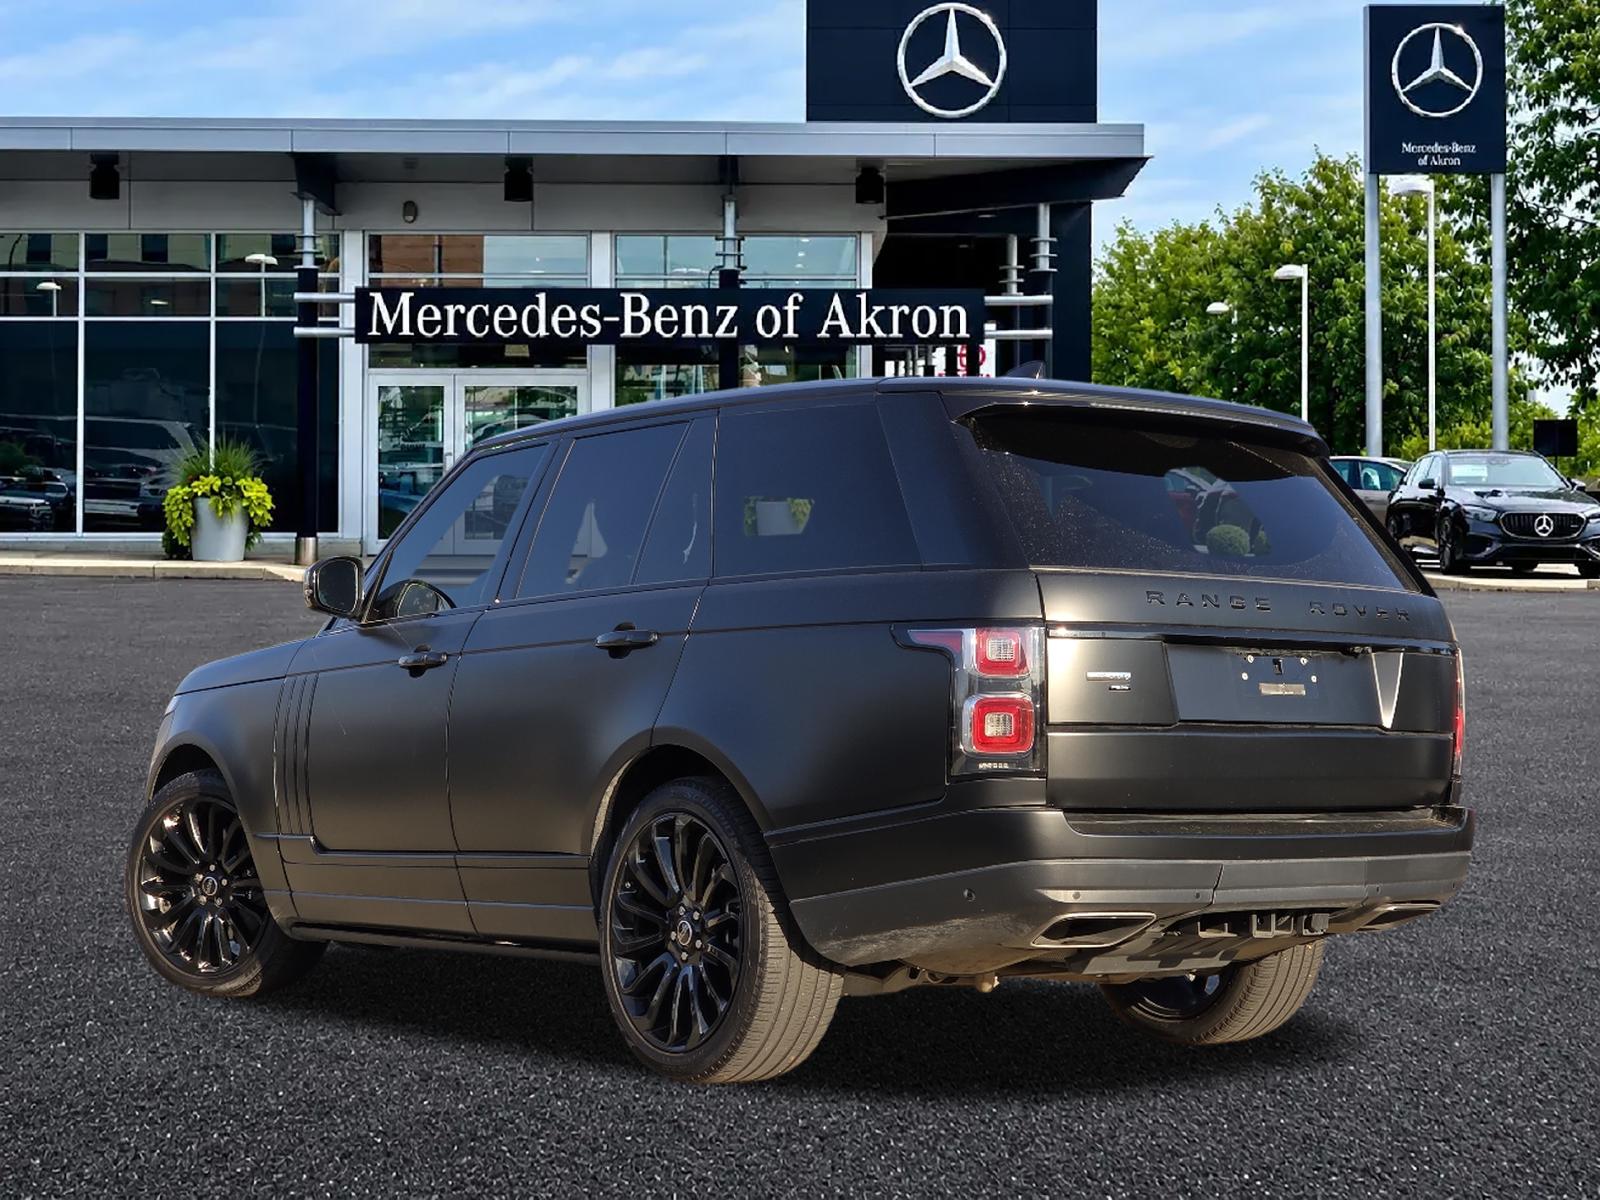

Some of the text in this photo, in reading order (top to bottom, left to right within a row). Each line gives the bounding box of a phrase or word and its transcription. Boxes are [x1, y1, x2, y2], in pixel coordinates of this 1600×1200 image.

[1401, 142, 1476, 153] Mercedes-Benz
[1417, 154, 1461, 166] of Akron
[367, 291, 970, 338] Mercedes-Benz of Akron
[1145, 590, 1411, 621] RANGE ROVER
